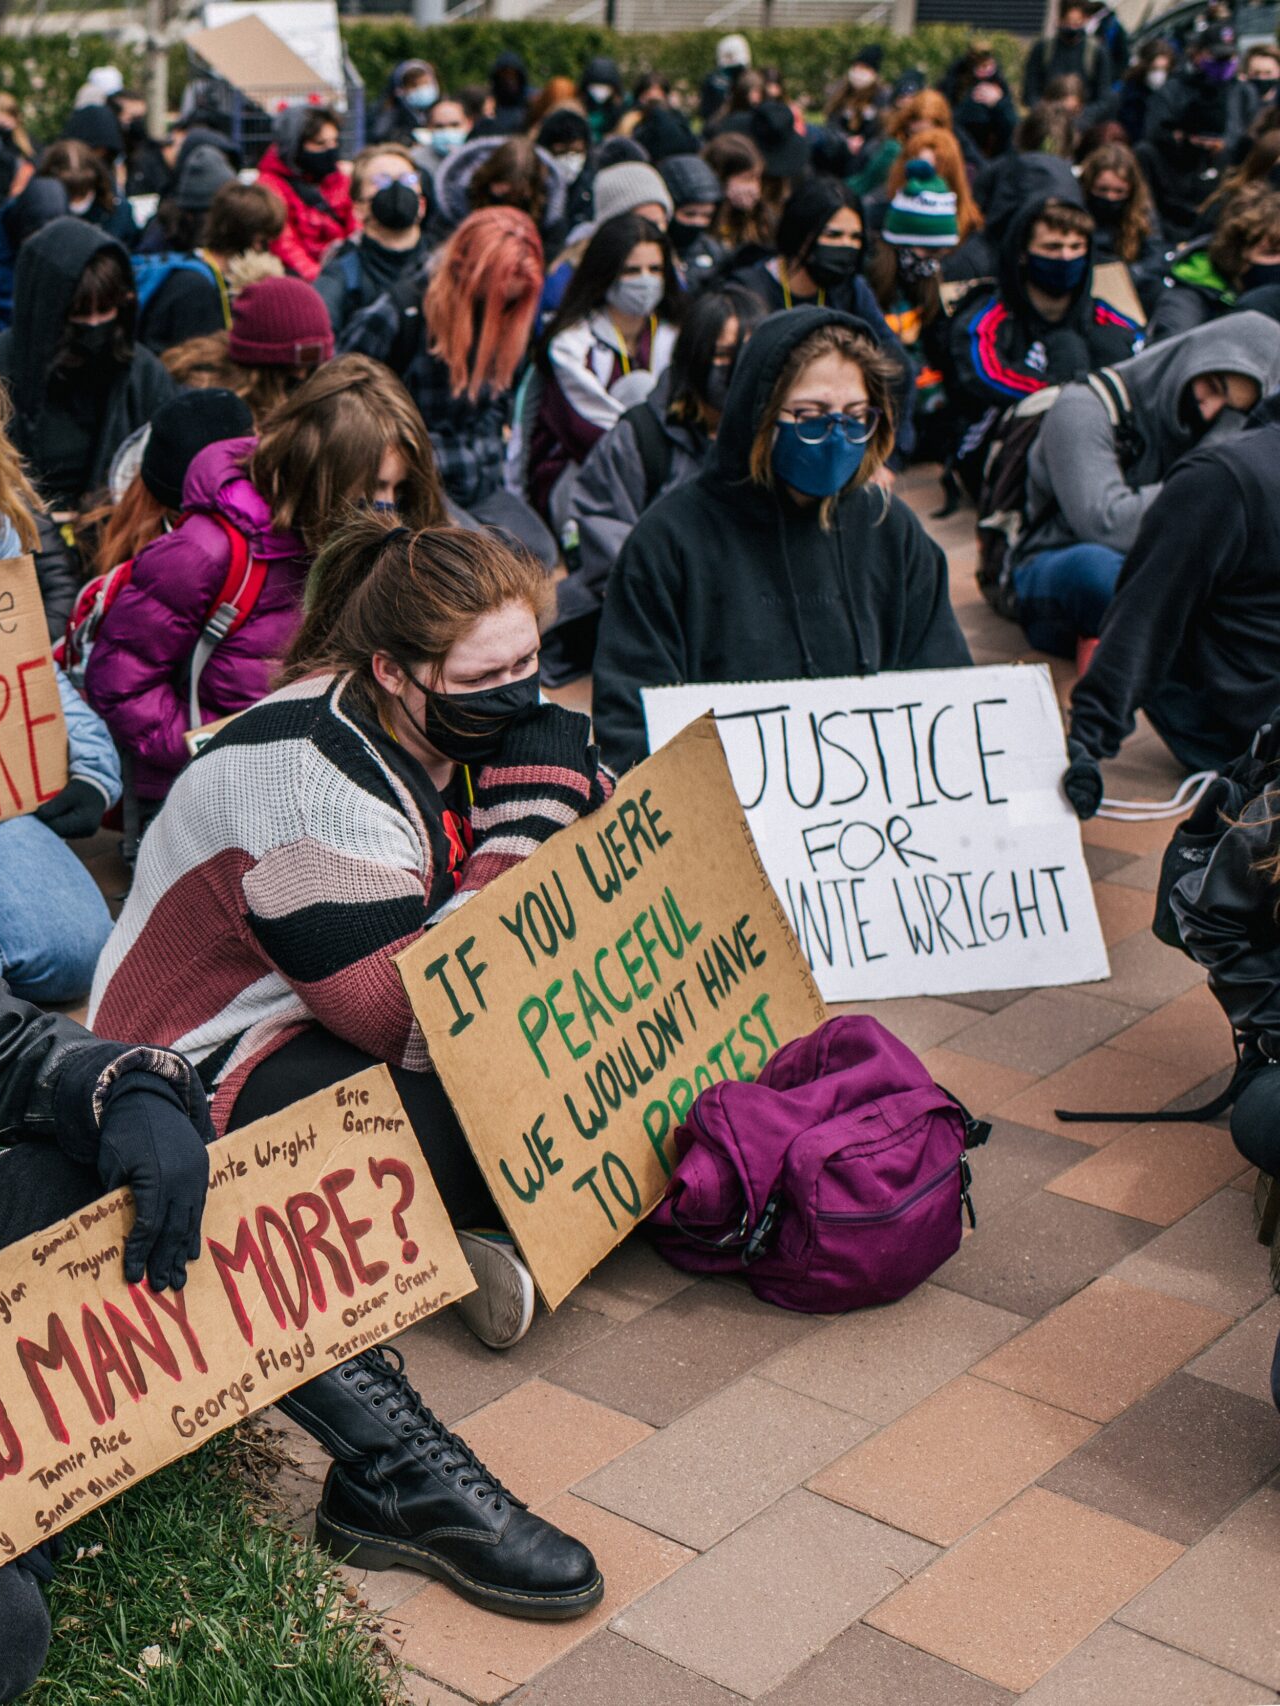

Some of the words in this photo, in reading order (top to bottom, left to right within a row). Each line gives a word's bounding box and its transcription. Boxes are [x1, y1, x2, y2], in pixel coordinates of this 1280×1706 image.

[713, 698, 1008, 810] JUSTICE
[802, 814, 938, 872] FOR
[424, 935, 488, 1037] IF
[499, 870, 577, 967] YOU
[575, 789, 673, 903] WERE
[770, 897, 800, 961] LIVES
[893, 866, 1069, 956] WRIGHT
[518, 886, 702, 1079] PEACEFUL
[499, 1112, 564, 1204] WE
[563, 979, 697, 1140] WOULDN'T
[696, 914, 767, 1010] HAVE
[334, 1085, 370, 1107] Eric
[342, 1110, 405, 1135] Garner
[254, 1123, 318, 1168] Wright
[572, 1150, 642, 1232] TO
[31, 1221, 80, 1267] Samuel
[57, 1245, 120, 1281] Trayvon
[16, 1278, 208, 1445] MANY
[206, 1156, 417, 1347] MORE?
[325, 1320, 390, 1361] Terrance
[393, 1290, 452, 1329] Crutcher
[341, 1290, 390, 1327] Oscar
[394, 1260, 439, 1296] Grant
[171, 1371, 256, 1438] George
[254, 1332, 316, 1380] Floyd
[28, 1451, 87, 1490] Tamir
[89, 1429, 132, 1460] Rice
[34, 1485, 87, 1534] Sandra
[86, 1456, 137, 1499] Bland
